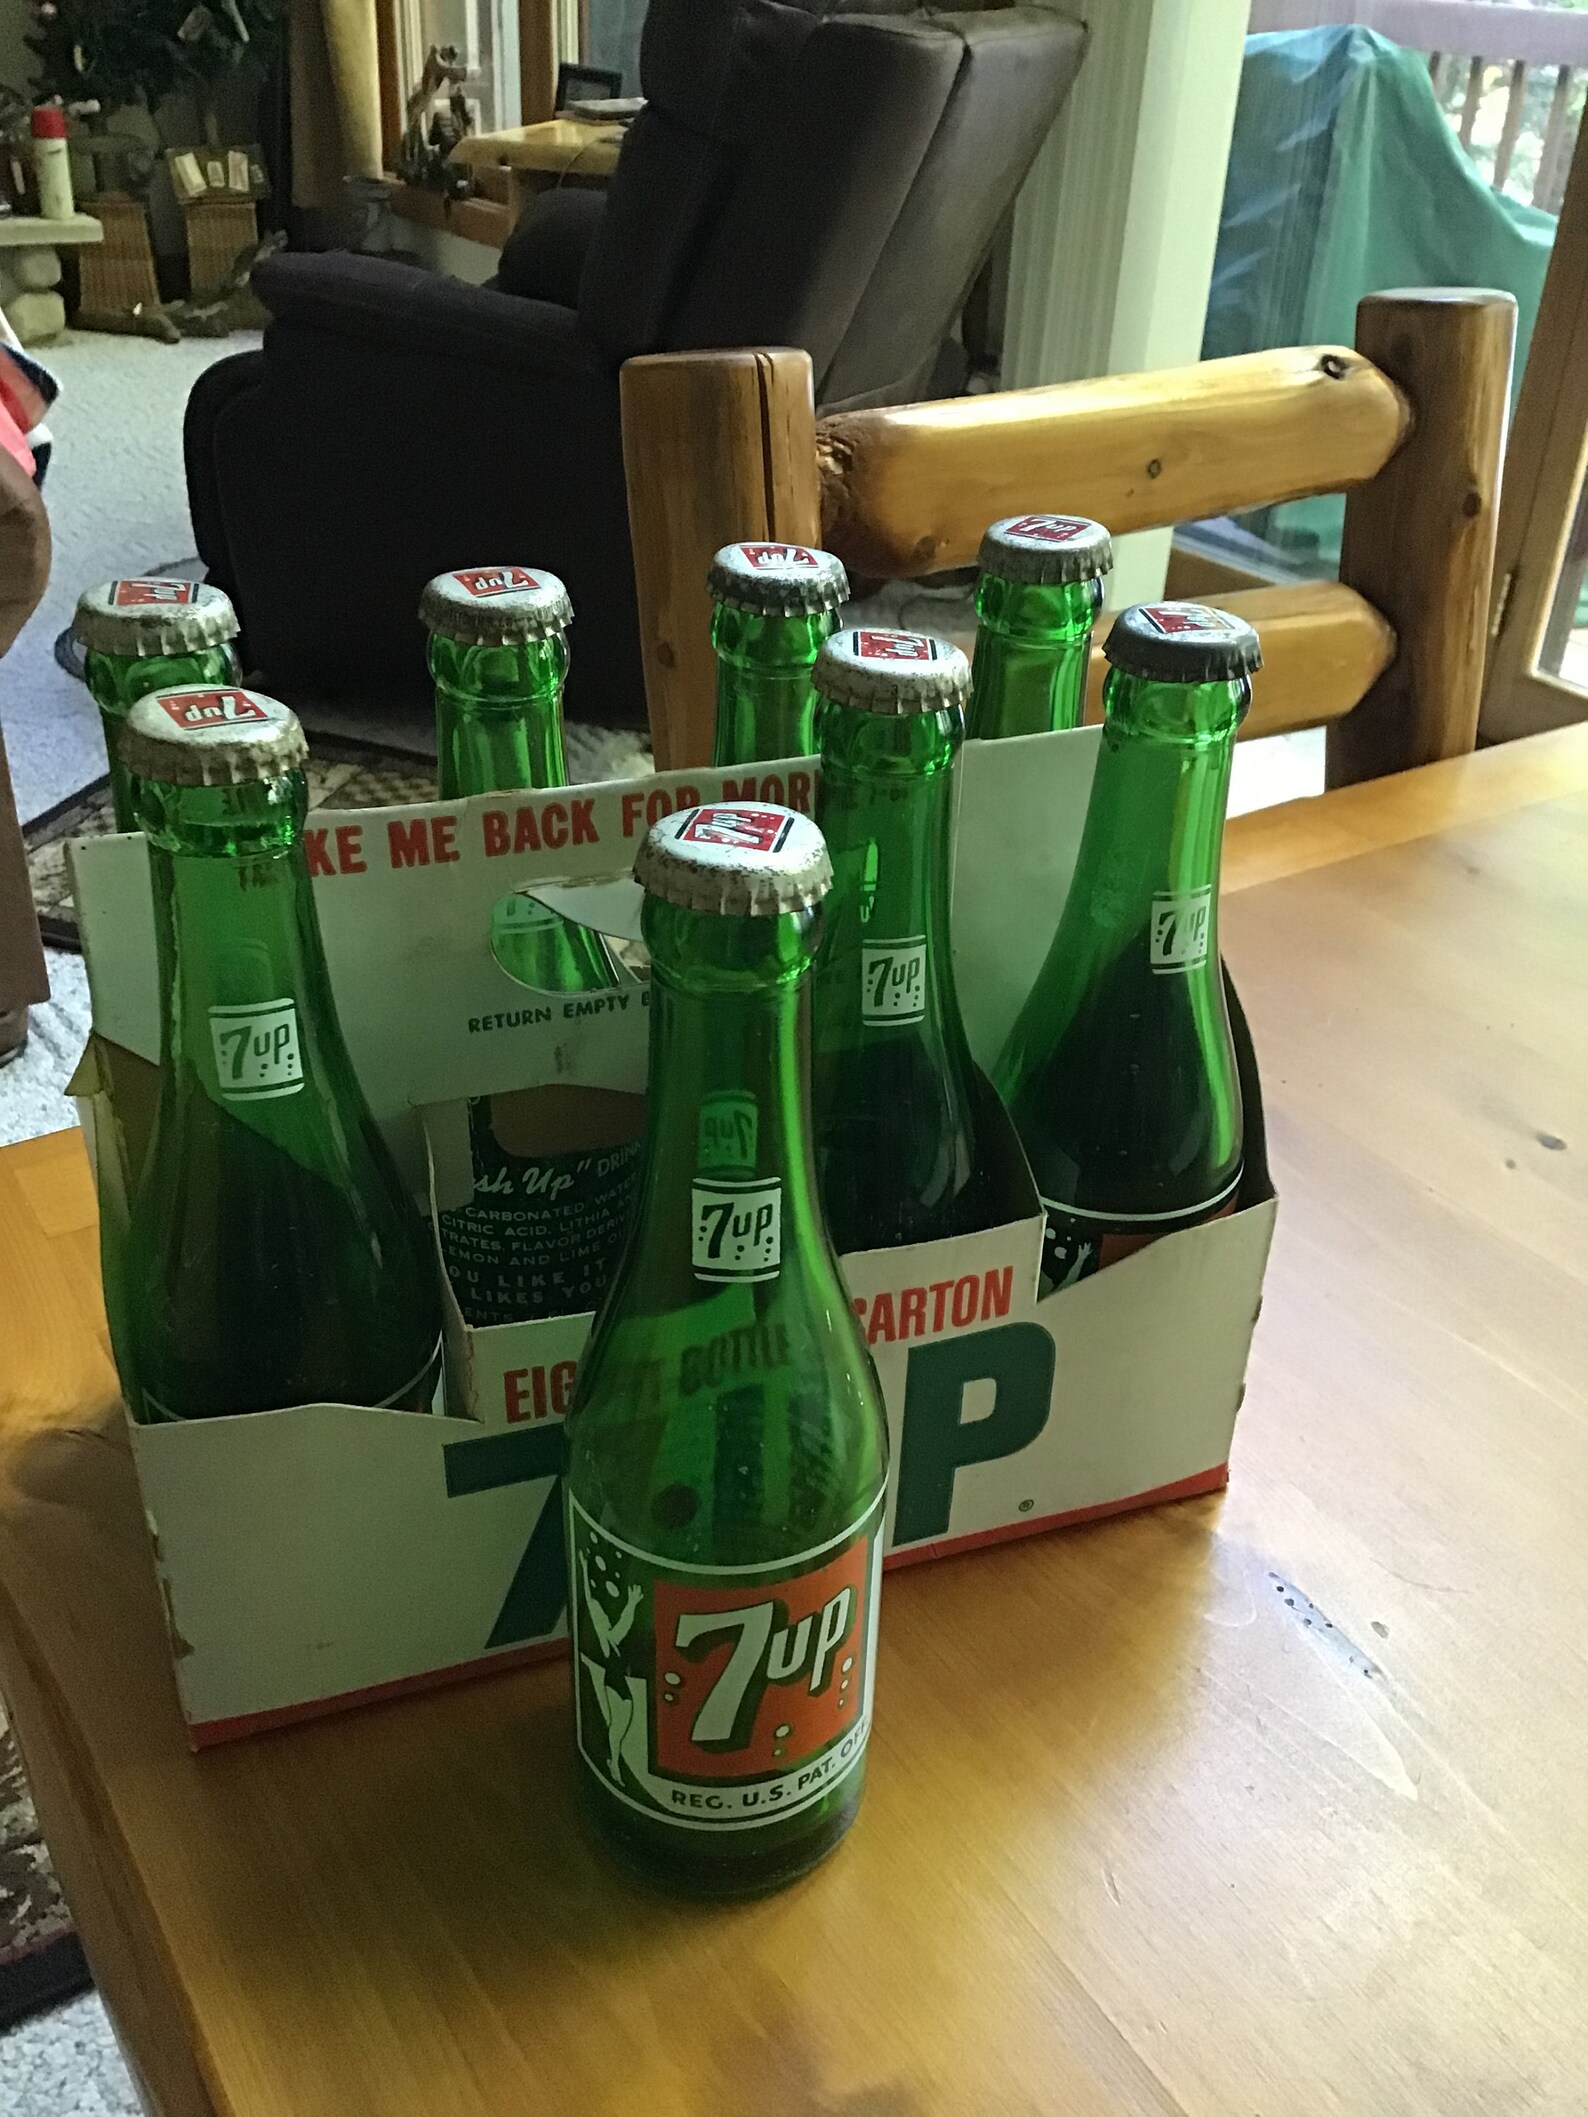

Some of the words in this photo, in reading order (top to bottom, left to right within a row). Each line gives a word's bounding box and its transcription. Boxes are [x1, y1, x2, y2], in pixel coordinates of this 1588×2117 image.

[303, 825, 368, 878] KE
[387, 815, 461, 870] ME
[483, 798, 600, 857] BACK
[468, 1006, 552, 1034] RETURN
[563, 995, 629, 1019] EMPTY
[441, 1214, 495, 1235] CITRIC
[465, 1201, 585, 1222] CARBONATED
[445, 1244, 500, 1265] EMON
[509, 1254, 550, 1266] AND
[560, 1241, 601, 1263] LIME
[511, 1233, 581, 1252] FLAVOR
[448, 1264, 481, 1284] OU
[498, 1271, 566, 1289] LIKE
[583, 1256, 606, 1277] IT
[470, 1286, 544, 1304] LIKES
[561, 1273, 606, 1299] YOU
[672, 1789, 733, 1810] REG.
[742, 1784, 792, 1808] U.S.
[798, 1756, 836, 1791] PAT.
